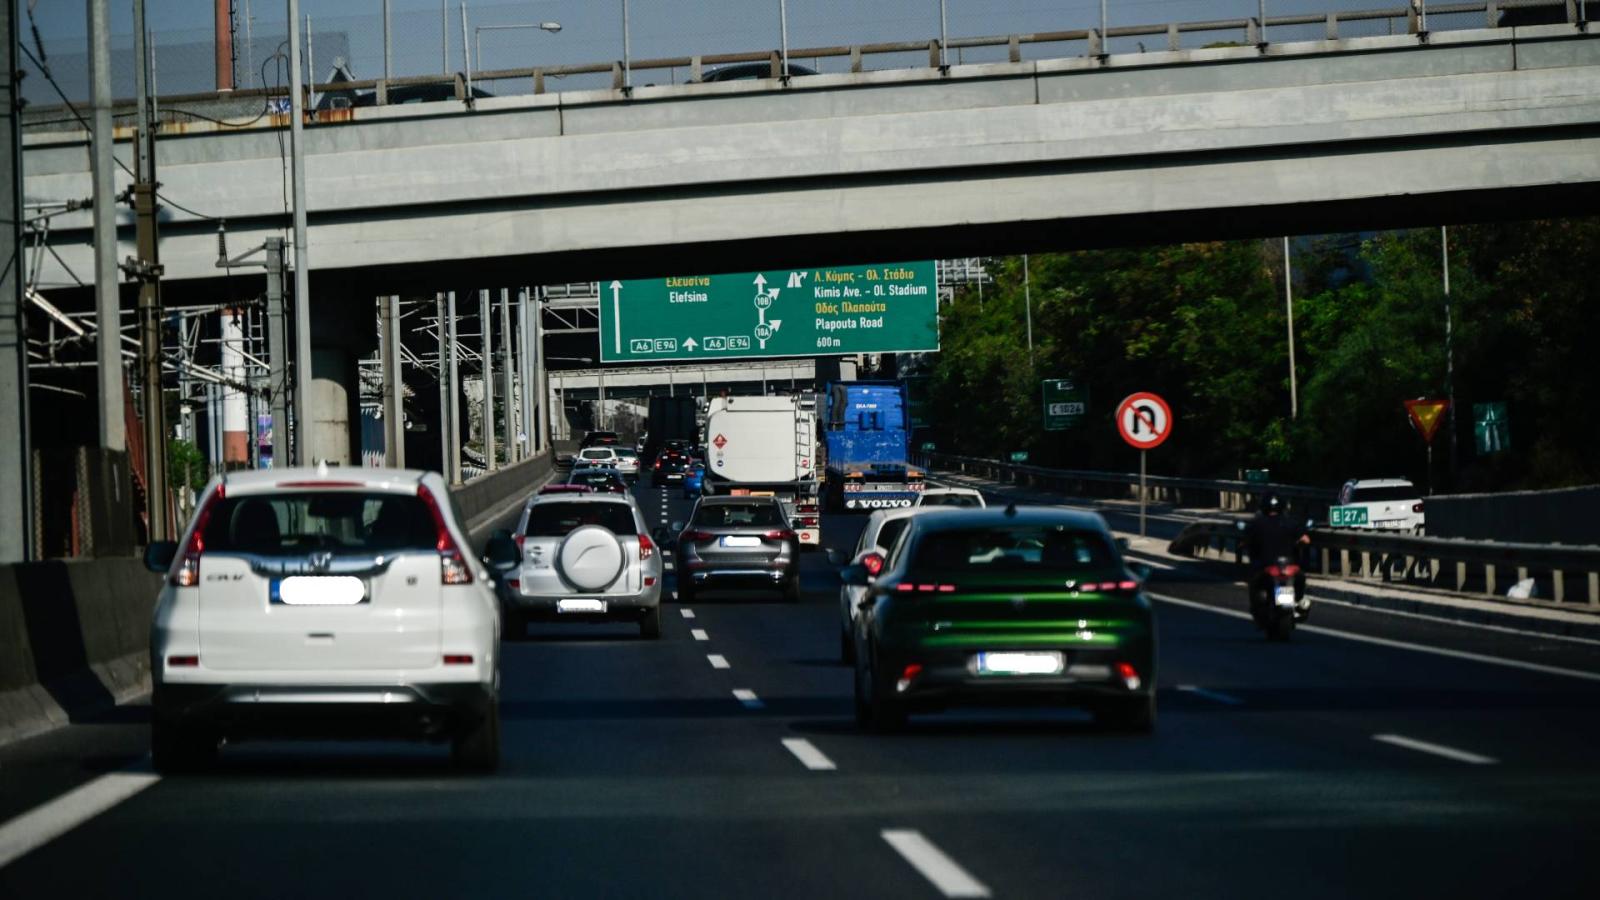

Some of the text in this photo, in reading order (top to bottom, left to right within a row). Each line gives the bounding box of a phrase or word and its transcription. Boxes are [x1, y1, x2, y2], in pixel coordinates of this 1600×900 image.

[814, 286, 841, 298] Kimis
[843, 286, 862, 297] Ave.
[889, 283, 927, 296] Stadium
[669, 291, 708, 303] Elefsina
[757, 297, 769, 305] 10B
[815, 316, 883, 332] Plapouta Road
[757, 328, 769, 336] 10A
[636, 343, 648, 351] A6
[709, 340, 721, 348] A6
[859, 499, 912, 509] VOLVO
[1333, 511, 1340, 522] E
